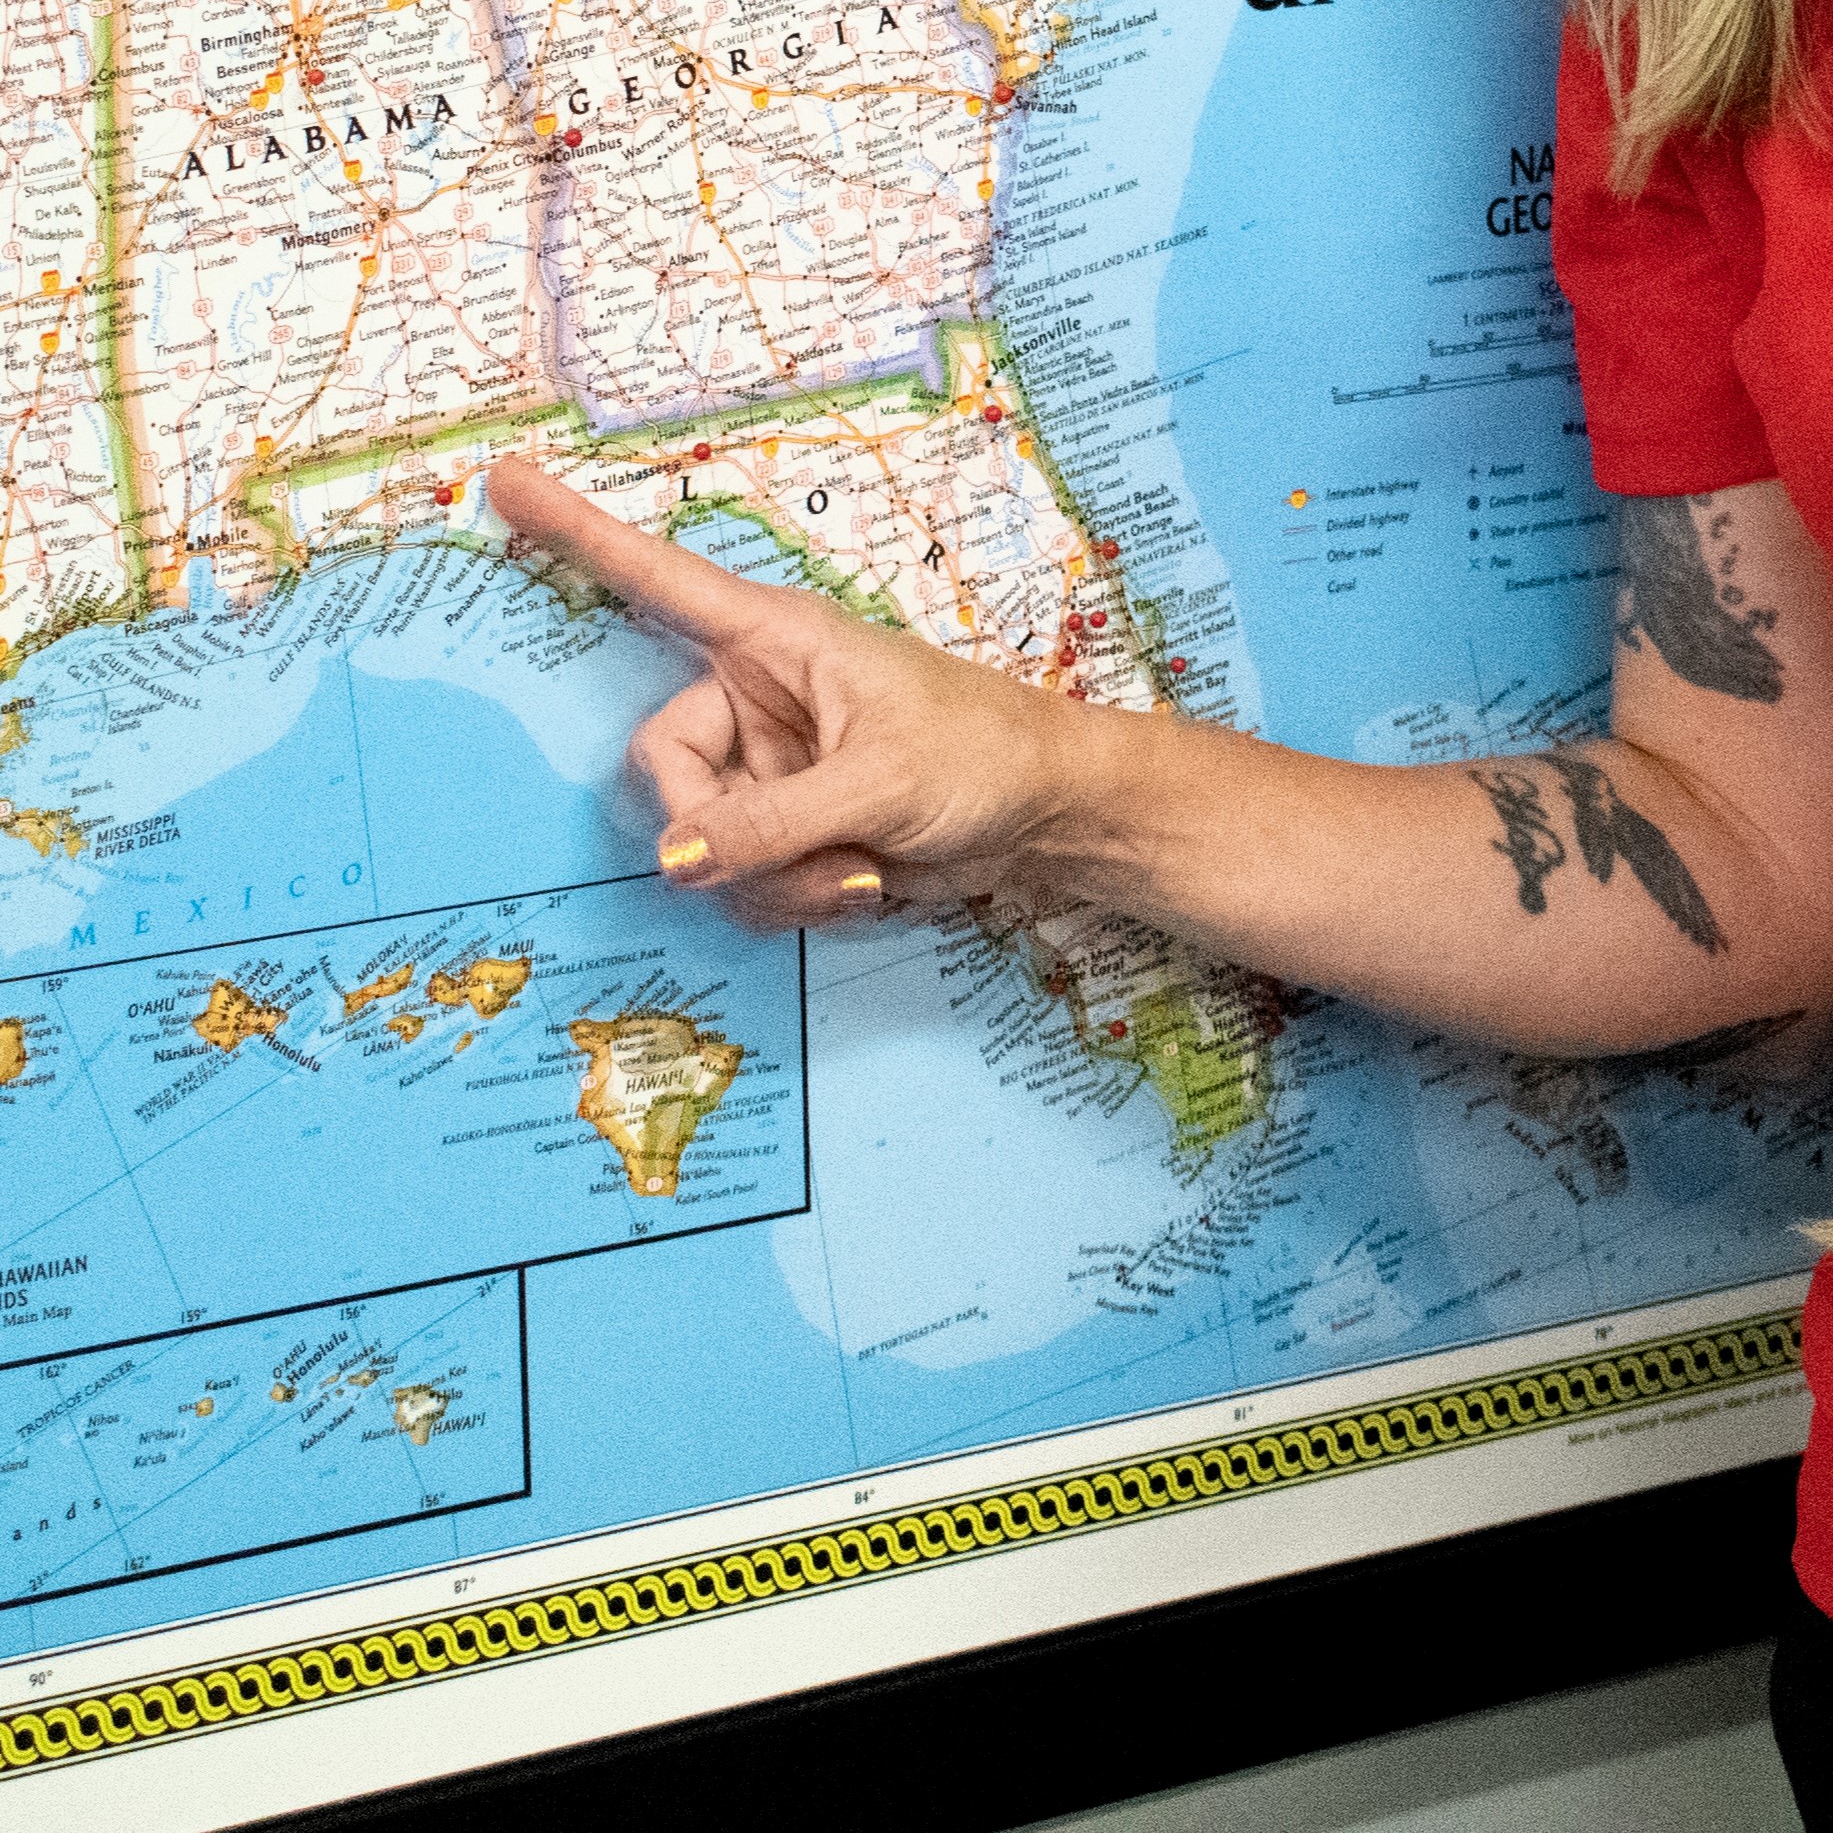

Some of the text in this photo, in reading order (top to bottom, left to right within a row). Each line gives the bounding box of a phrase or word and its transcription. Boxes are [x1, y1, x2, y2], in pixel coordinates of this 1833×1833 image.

[201, 24, 294, 51] Birmingham
[569, 7, 898, 115] GEORGIA
[183, 94, 457, 179] ALABAMA
[281, 220, 375, 251] Montgomery
[991, 318, 1080, 373] Jacksonville
[591, 460, 682, 490] Tallahassee
[198, 527, 248, 550] Mobile
[96, 813, 177, 844] MISSISSIPPI
[68, 862, 363, 951] MEXICO
[497, 901, 522, 916] 156°
[41, 976, 69, 995] 159°
[629, 1223, 654, 1236] 156°
[180, 1308, 207, 1324] 159°
[340, 1306, 367, 1321] 156°
[420, 1494, 446, 1509] 156°
[455, 1577, 475, 1593] 87°
[29, 1670, 52, 1686] 90°
